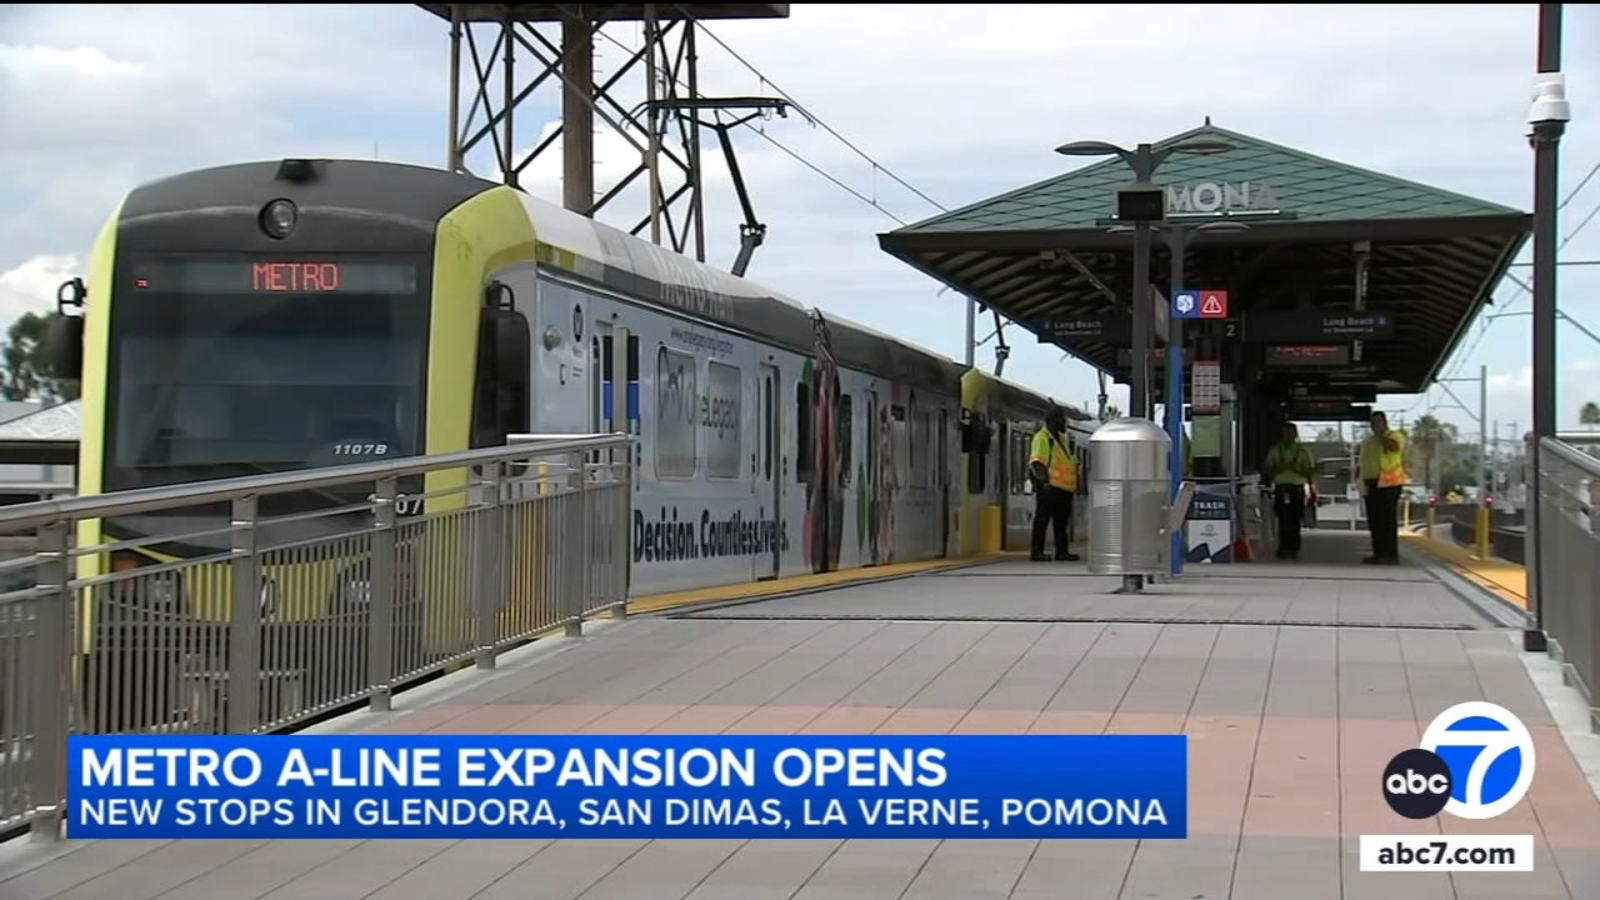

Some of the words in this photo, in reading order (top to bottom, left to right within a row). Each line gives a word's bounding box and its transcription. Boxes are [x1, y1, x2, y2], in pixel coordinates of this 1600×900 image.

[1166, 181, 1280, 212] MONA
[252, 262, 339, 291] METRO
[1226, 324, 1236, 337] 2
[333, 443, 388, 455] 1107B
[366, 493, 422, 516] 107
[1193, 501, 1226, 510] TRASH
[633, 505, 699, 564] Decision.
